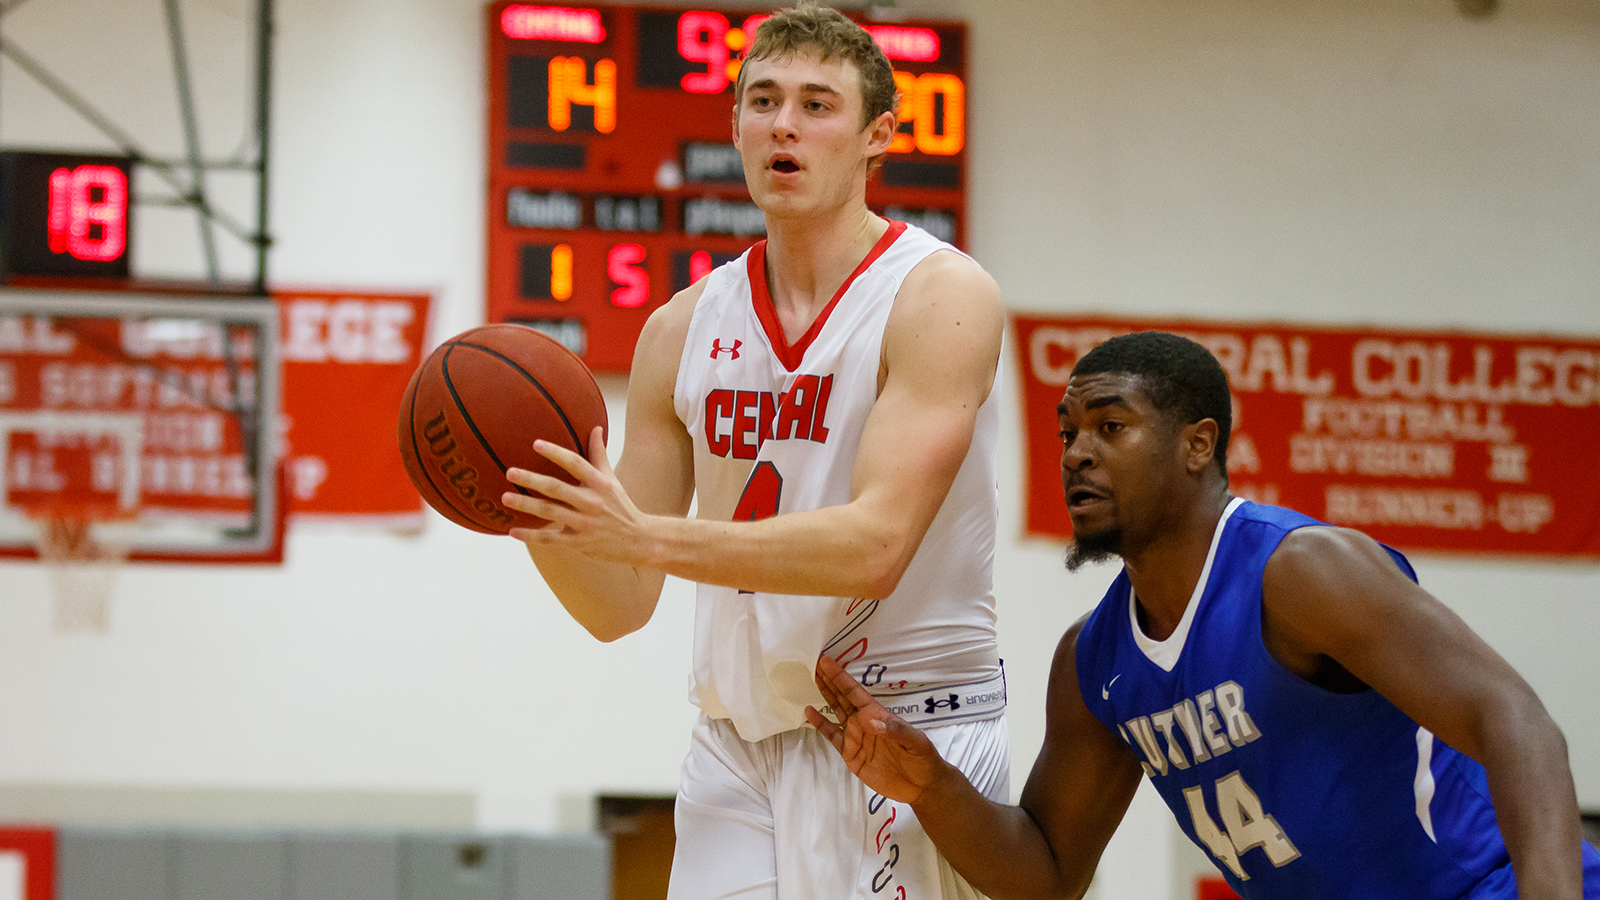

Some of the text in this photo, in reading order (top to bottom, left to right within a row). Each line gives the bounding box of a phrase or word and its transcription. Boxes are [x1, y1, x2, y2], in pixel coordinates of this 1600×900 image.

[548, 55, 617, 134] 14
[885, 70, 965, 156] 20
[48, 165, 128, 262] 18
[551, 244, 573, 301] 1
[607, 243, 650, 308] 5
[1352, 338, 1600, 405] COLLEG
[1304, 398, 1515, 442] FOOTBALL
[423, 409, 517, 525] Wilson
[1290, 434, 1454, 477] DIVISION
[1325, 484, 1555, 532] RUNNER-UP
[1182, 770, 1302, 881] 44
